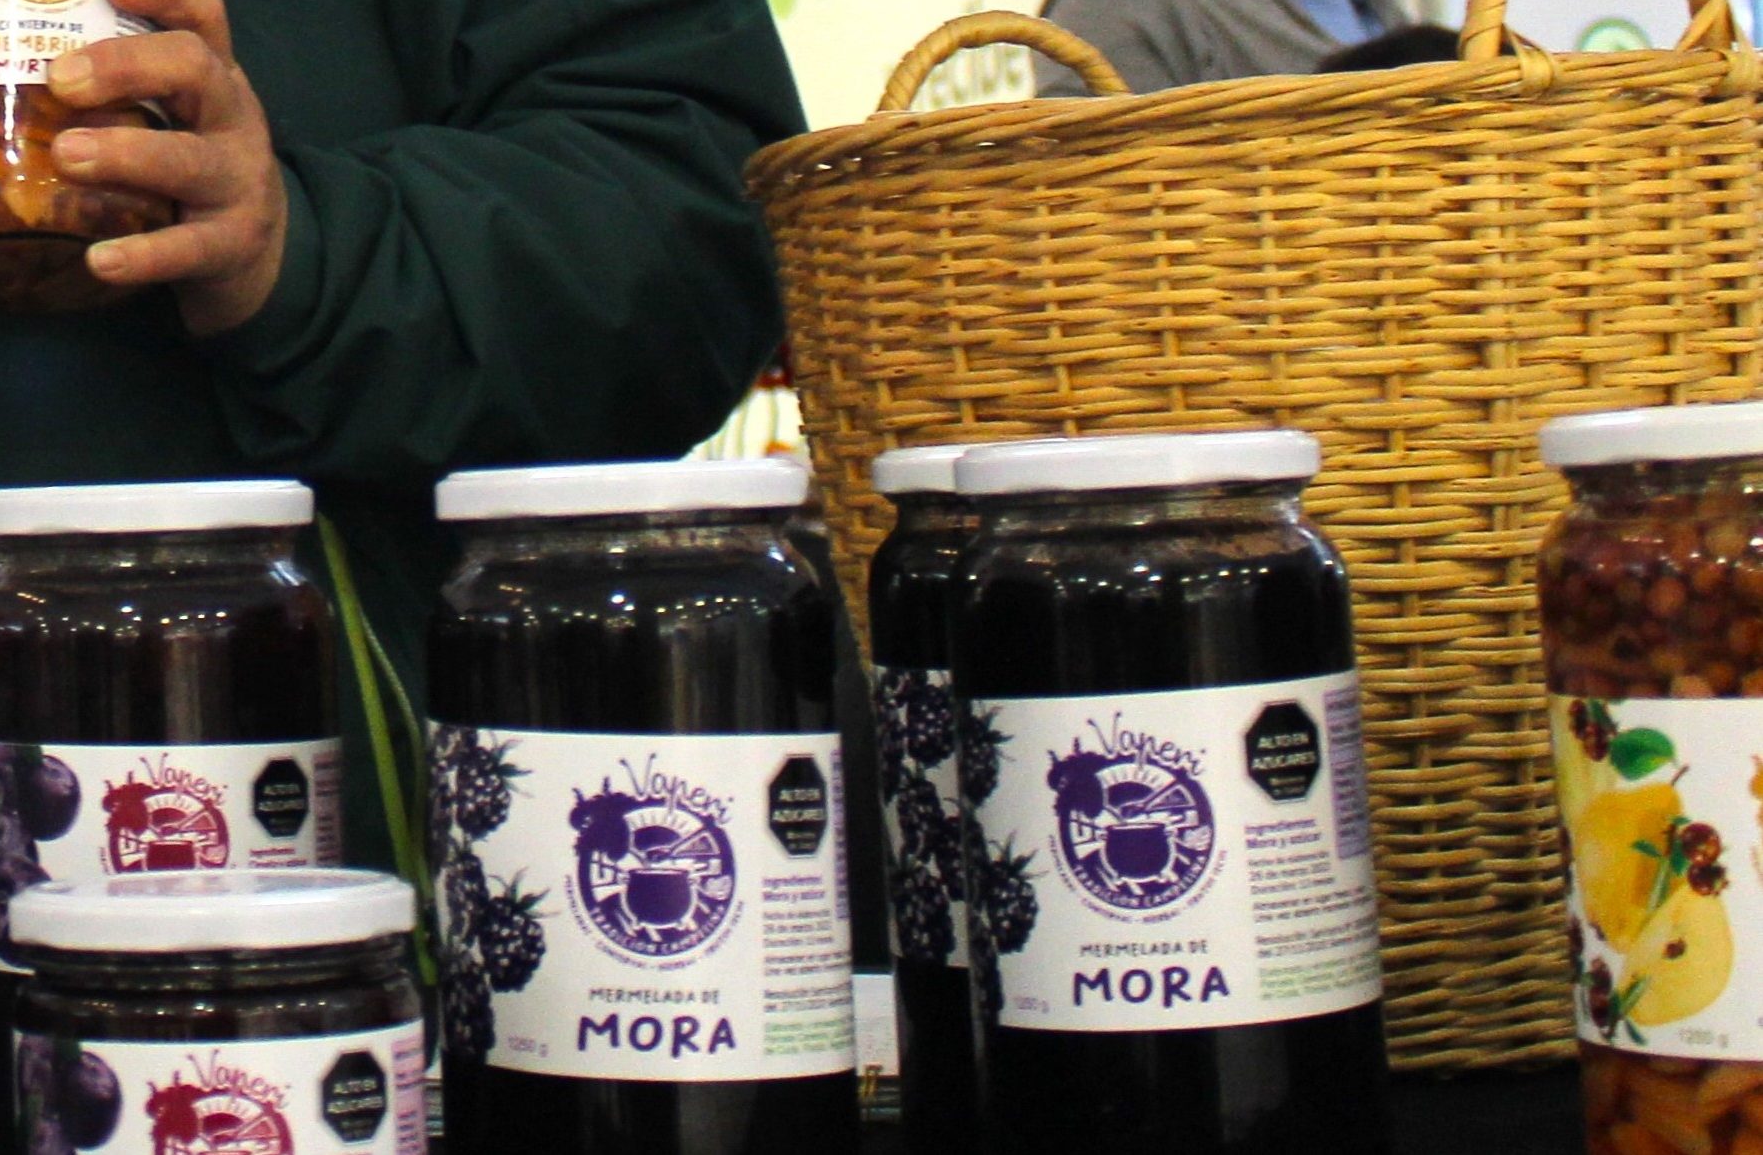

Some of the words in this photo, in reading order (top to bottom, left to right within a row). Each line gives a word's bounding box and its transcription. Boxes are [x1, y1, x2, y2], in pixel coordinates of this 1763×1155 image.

[1080, 941, 1184, 958] MERMELADA
[1189, 938, 1209, 954] DE
[589, 988, 696, 1004] MERMELADA
[702, 989, 720, 1004] DE
[1073, 965, 1230, 1009] MORA
[576, 1012, 737, 1059] MORA
